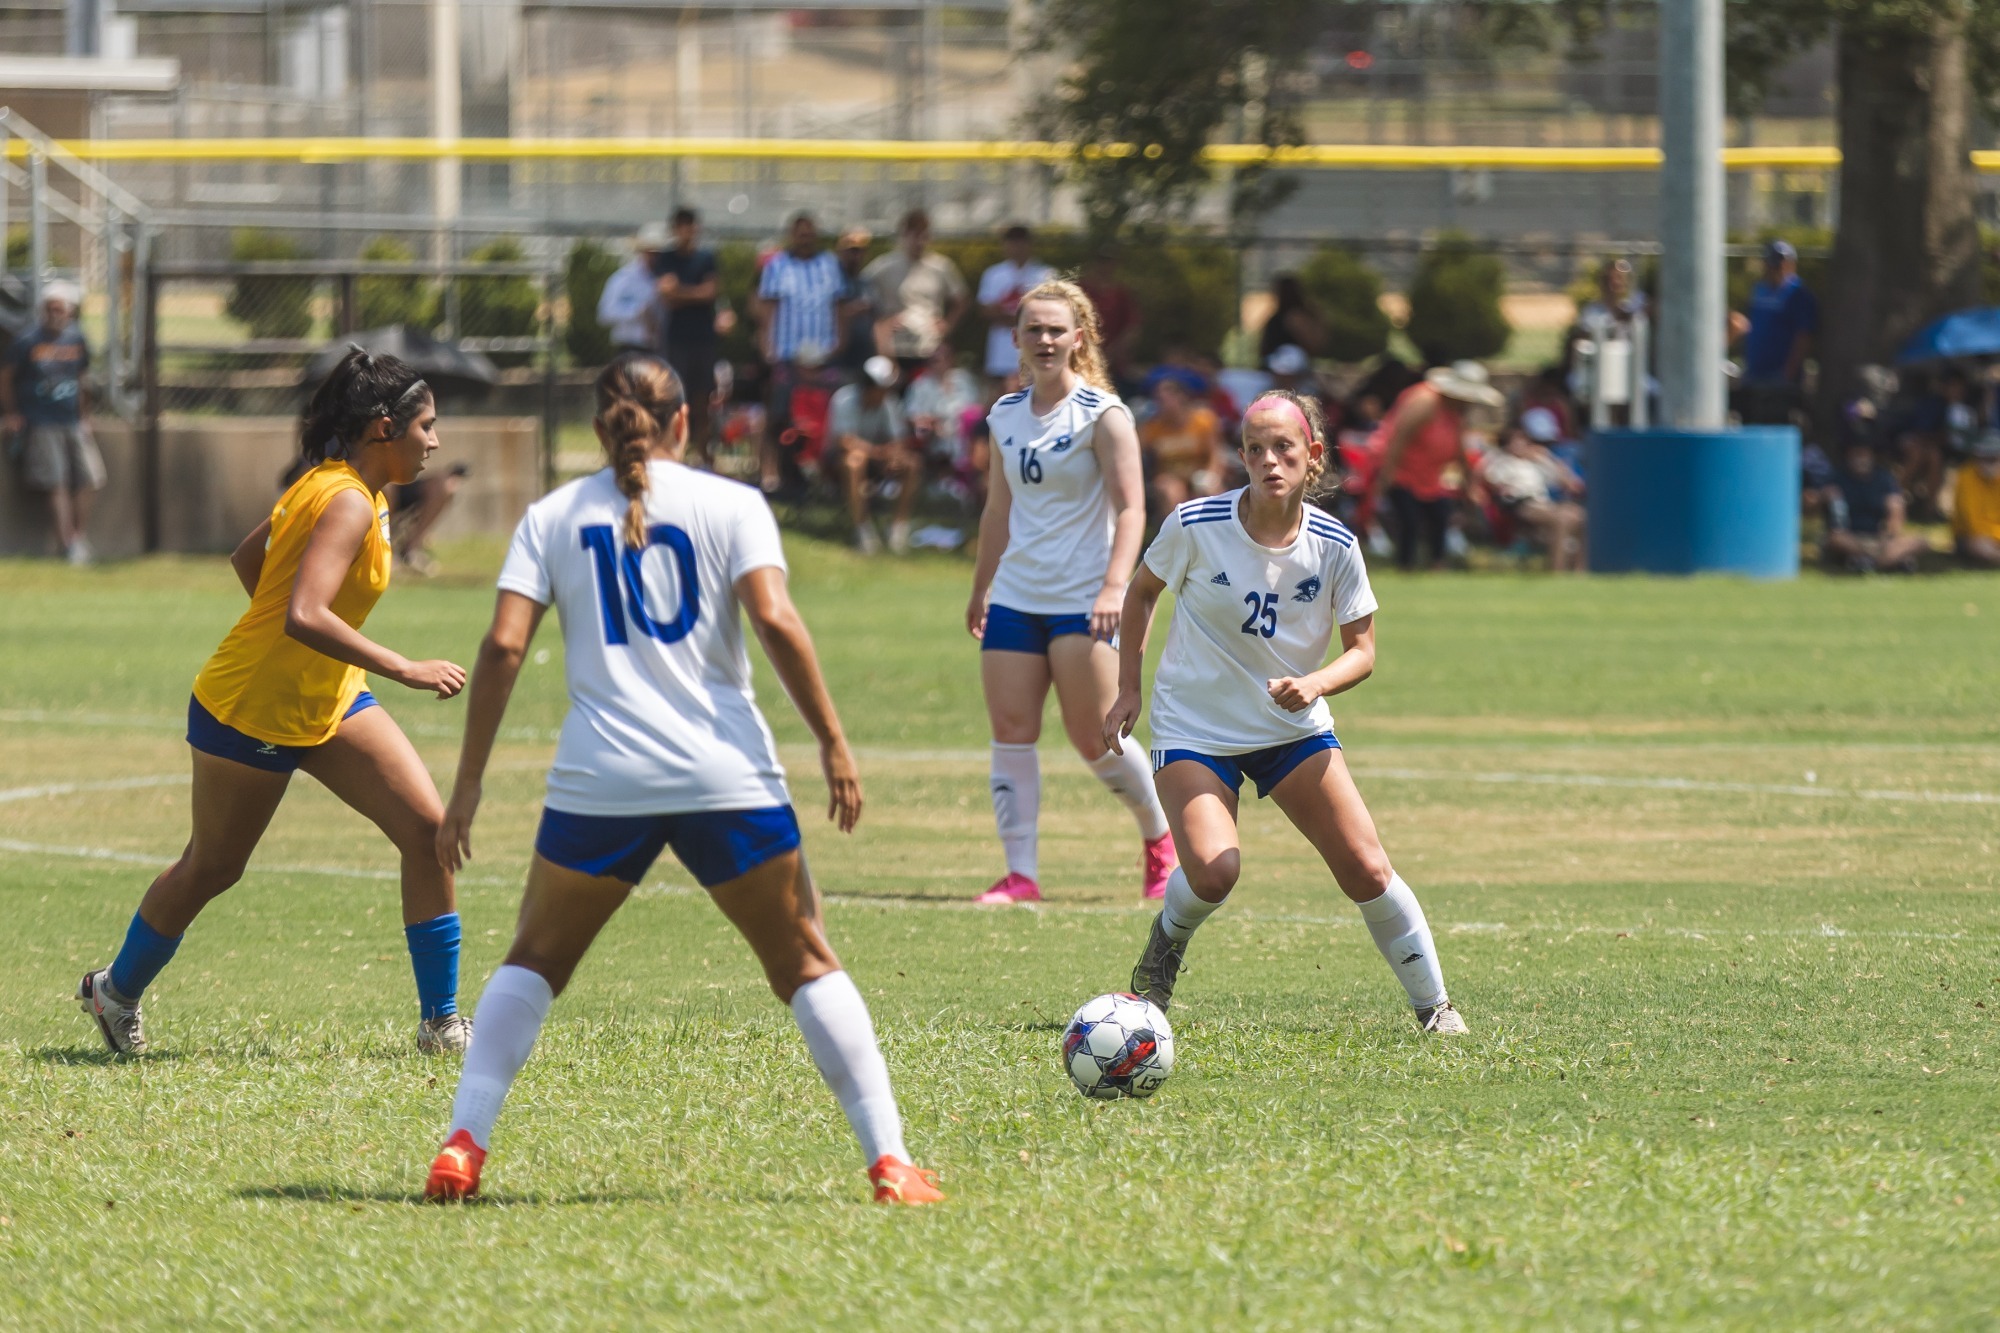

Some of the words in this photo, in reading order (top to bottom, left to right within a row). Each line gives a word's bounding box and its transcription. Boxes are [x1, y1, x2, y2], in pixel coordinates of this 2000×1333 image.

[1019, 448, 1043, 485] 16
[579, 523, 700, 645] 10
[1241, 591, 1280, 639] 25
